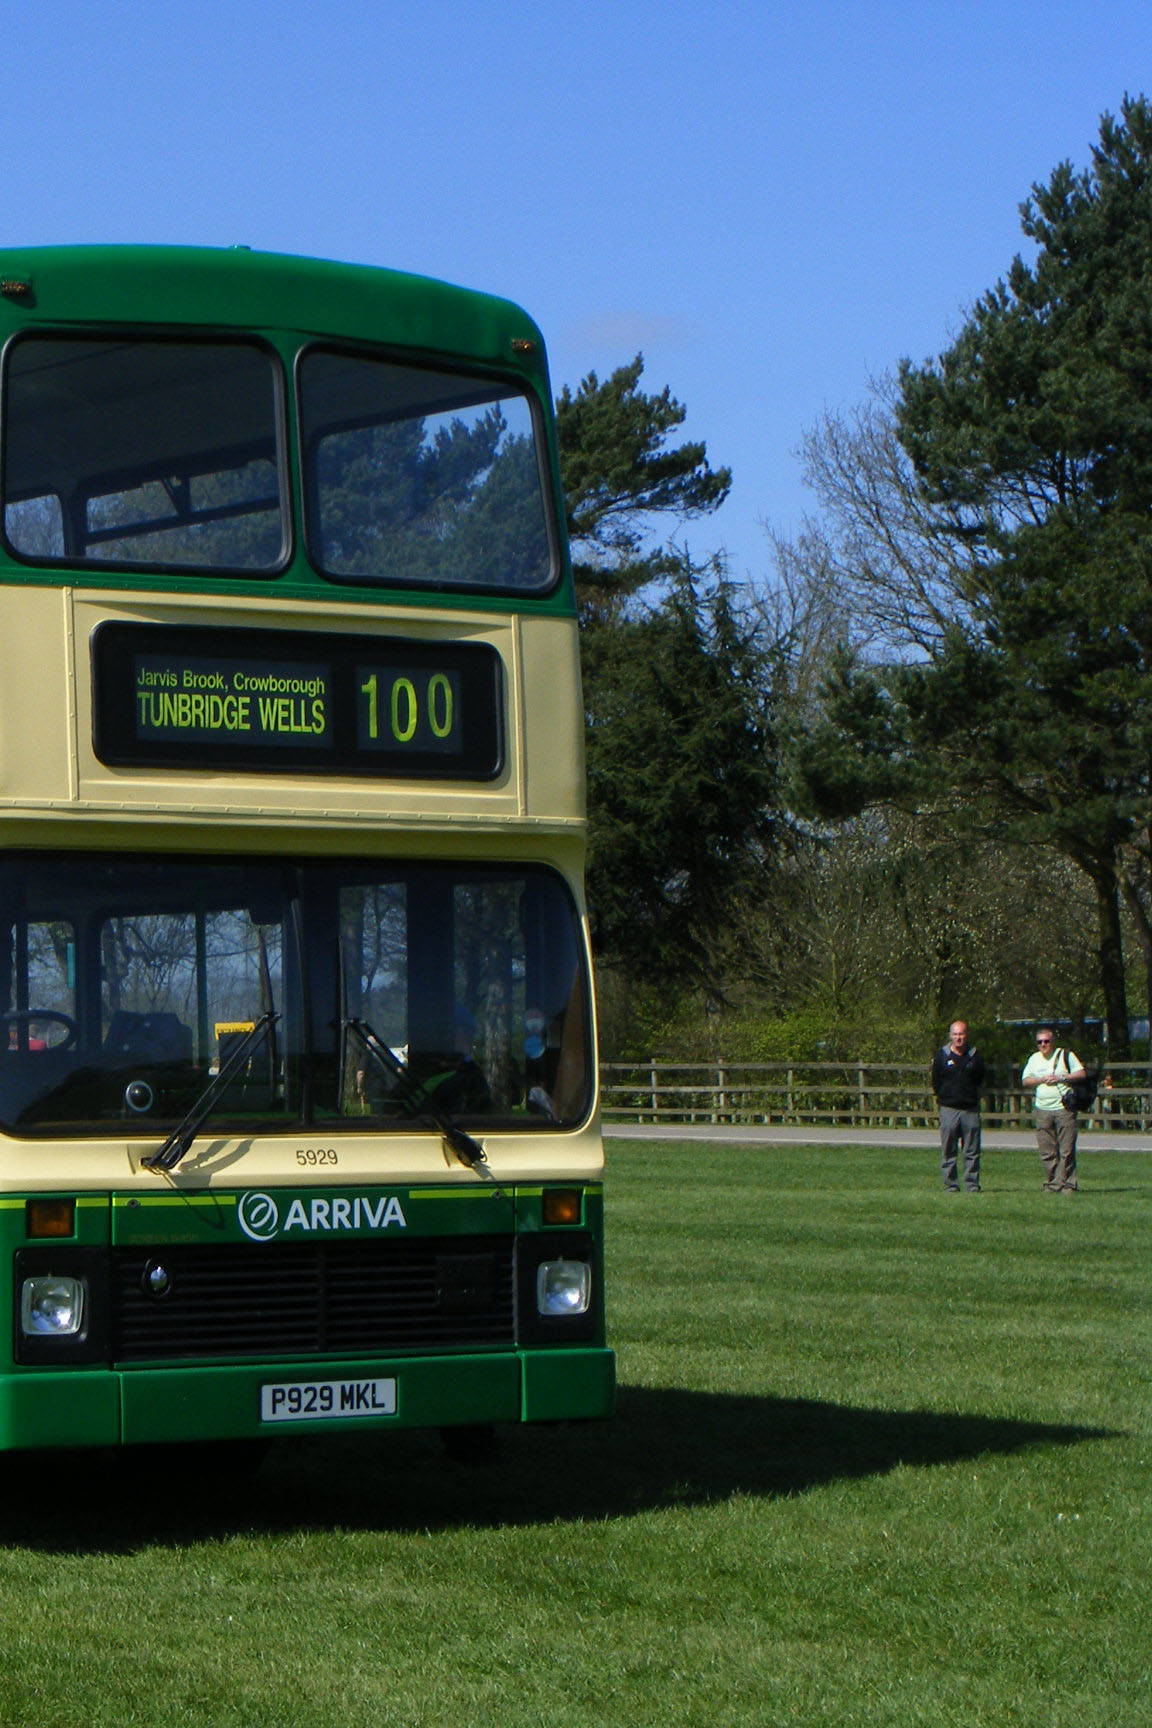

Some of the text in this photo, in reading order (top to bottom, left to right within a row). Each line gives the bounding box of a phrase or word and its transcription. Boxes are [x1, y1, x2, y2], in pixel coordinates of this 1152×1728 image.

[137, 668, 325, 698] Jarvis Brook, Crowborough
[137, 692, 326, 734] TUNBRIDGE WELLS
[361, 673, 453, 742] 100
[296, 1149, 338, 1166] 5929
[283, 1197, 407, 1231] ARRIVA
[272, 1382, 385, 1415] P929 MKL
